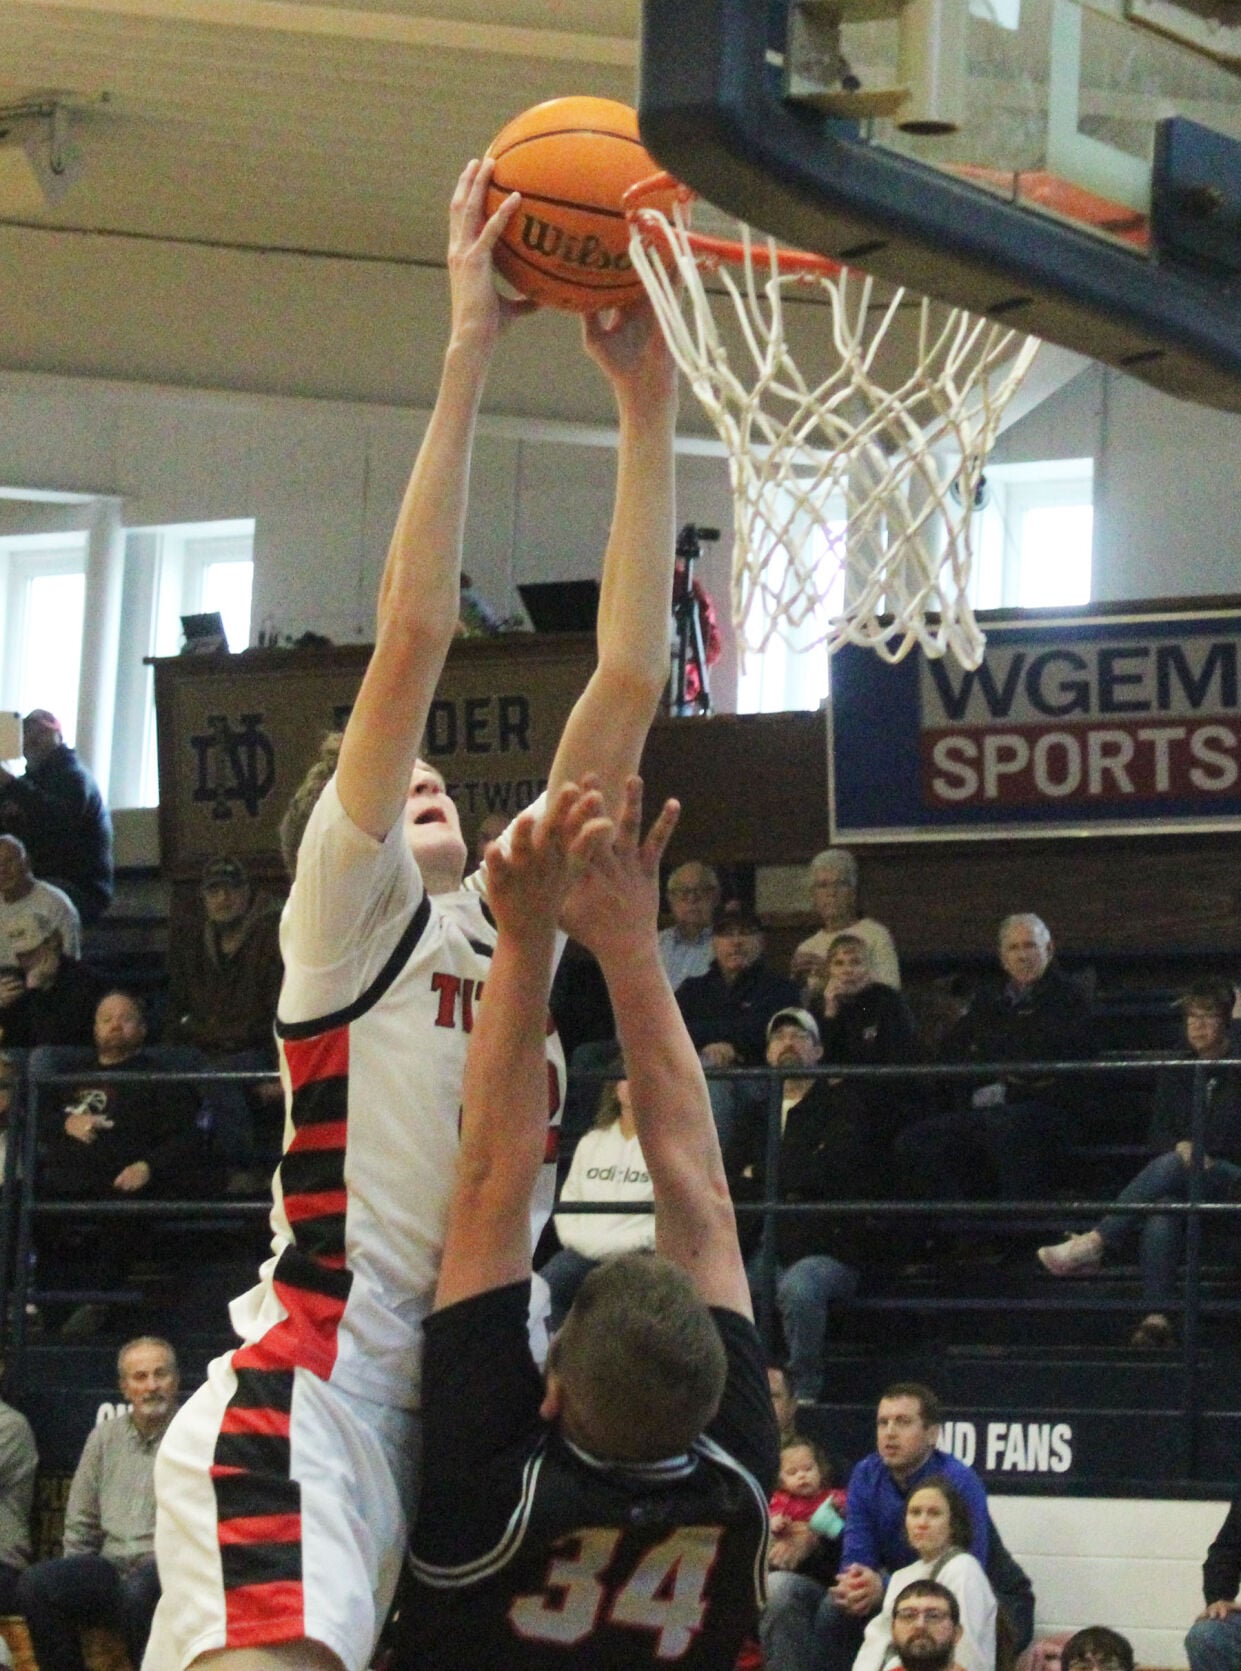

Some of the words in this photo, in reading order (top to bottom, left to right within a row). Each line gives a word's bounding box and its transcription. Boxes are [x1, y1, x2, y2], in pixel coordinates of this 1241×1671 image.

[926, 643, 1240, 720] WGEM
[931, 725, 1239, 801] SPORTS
[986, 1422, 1072, 1473] FANS
[508, 1525, 726, 1661] 34
